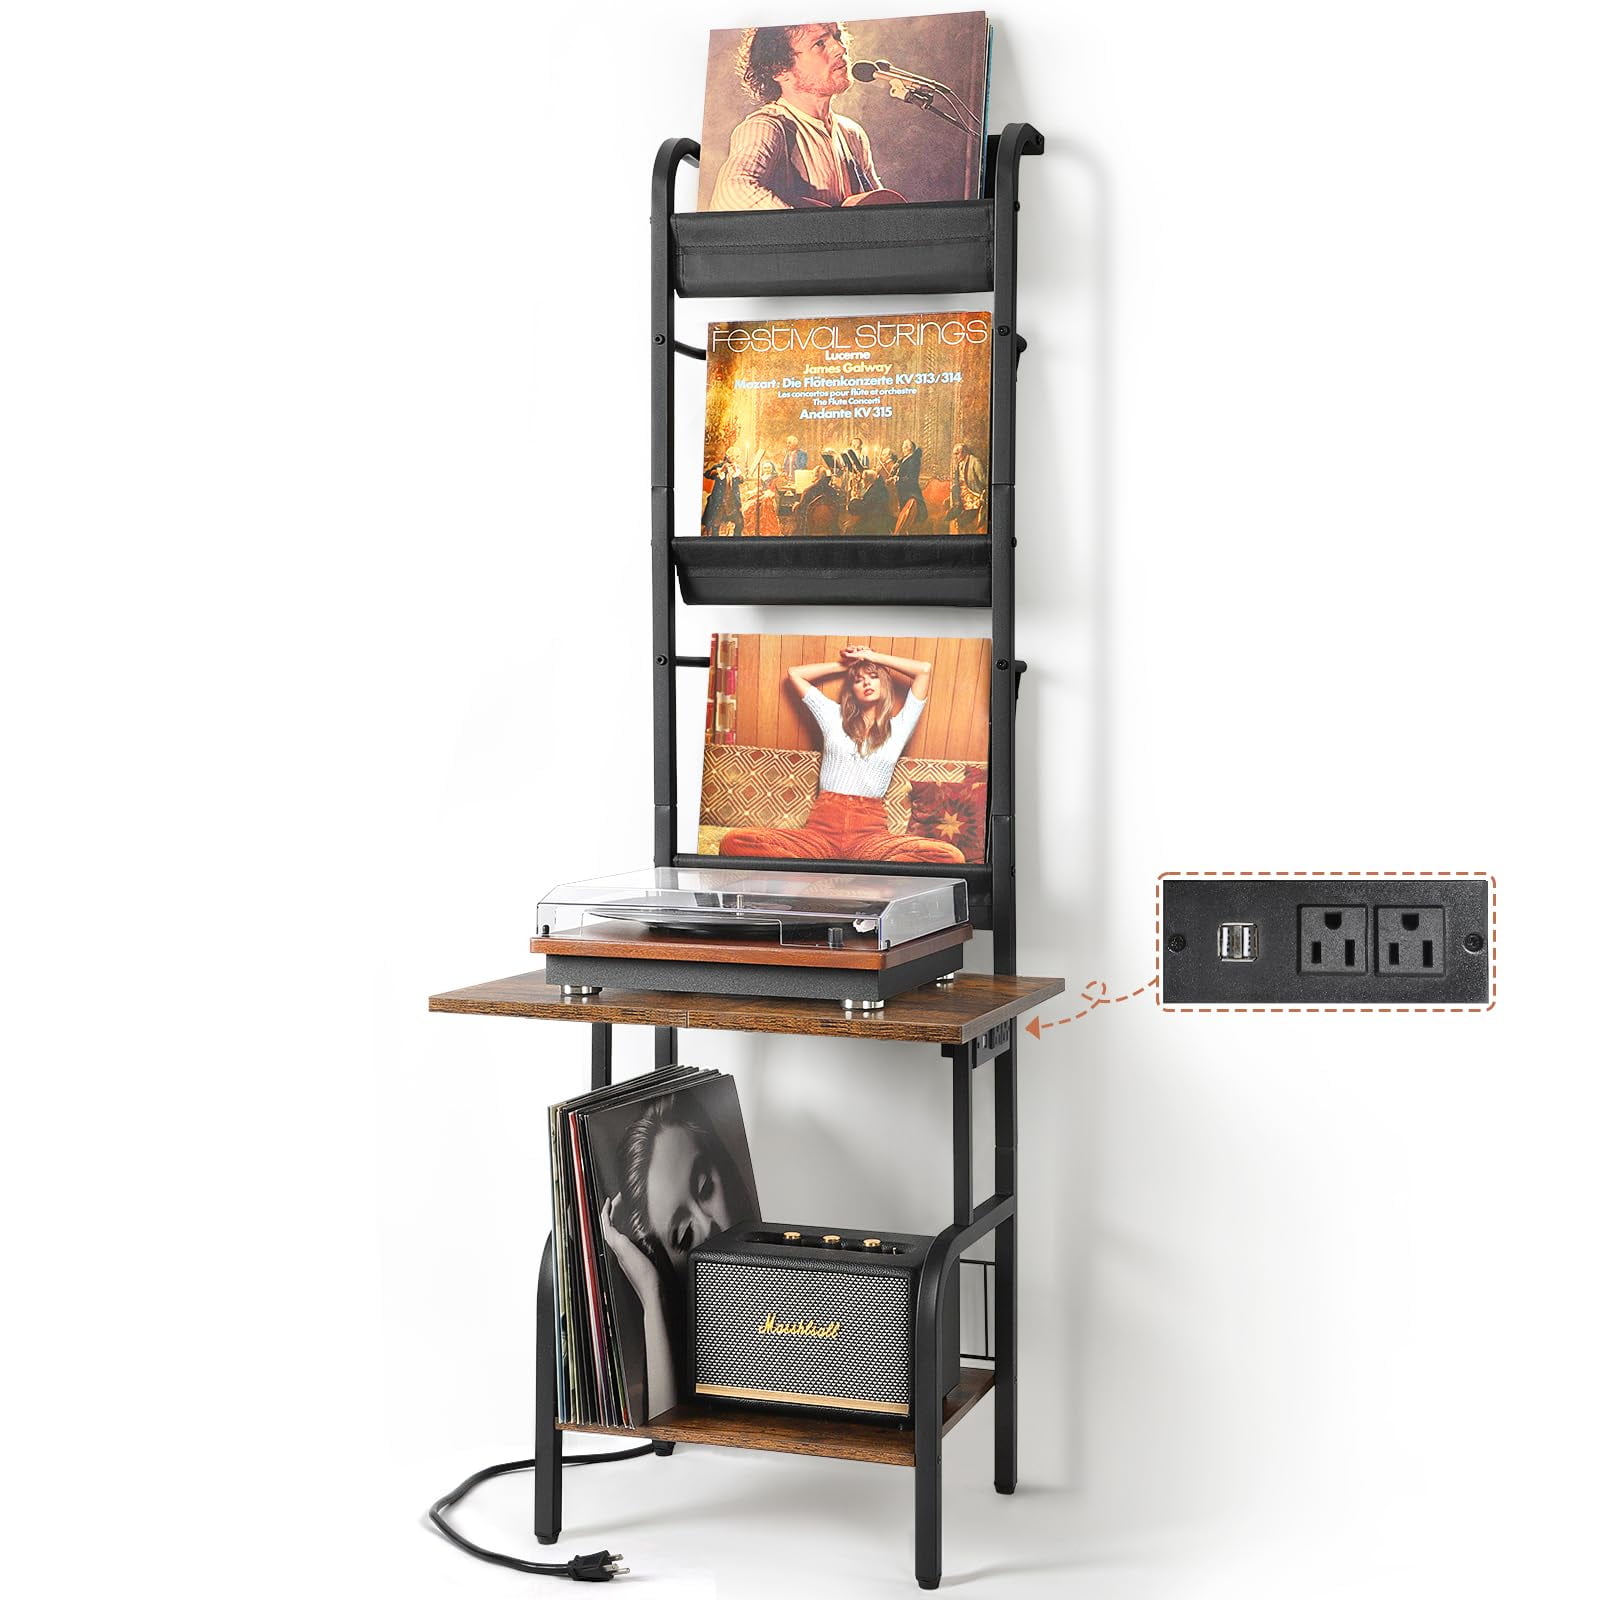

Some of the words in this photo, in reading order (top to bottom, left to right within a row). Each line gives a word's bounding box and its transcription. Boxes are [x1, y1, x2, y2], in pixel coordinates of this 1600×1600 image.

[825, 350, 871, 361] Lucerne
[803, 364, 841, 375] James
[842, 361, 893, 375] Galway
[782, 377, 802, 389] Die
[803, 375, 894, 389] Flötenkonzerte
[895, 374, 914, 385] KV
[915, 372, 962, 385] 313/314
[778, 391, 791, 399] Les
[829, 389, 850, 399] pour
[870, 387, 879, 396] et
[879, 386, 917, 395] orchestre
[813, 398, 827, 407] The
[828, 397, 847, 406] Flute
[800, 408, 852, 420] Andante
[853, 408, 873, 419] KV
[873, 406, 893, 418] 315
